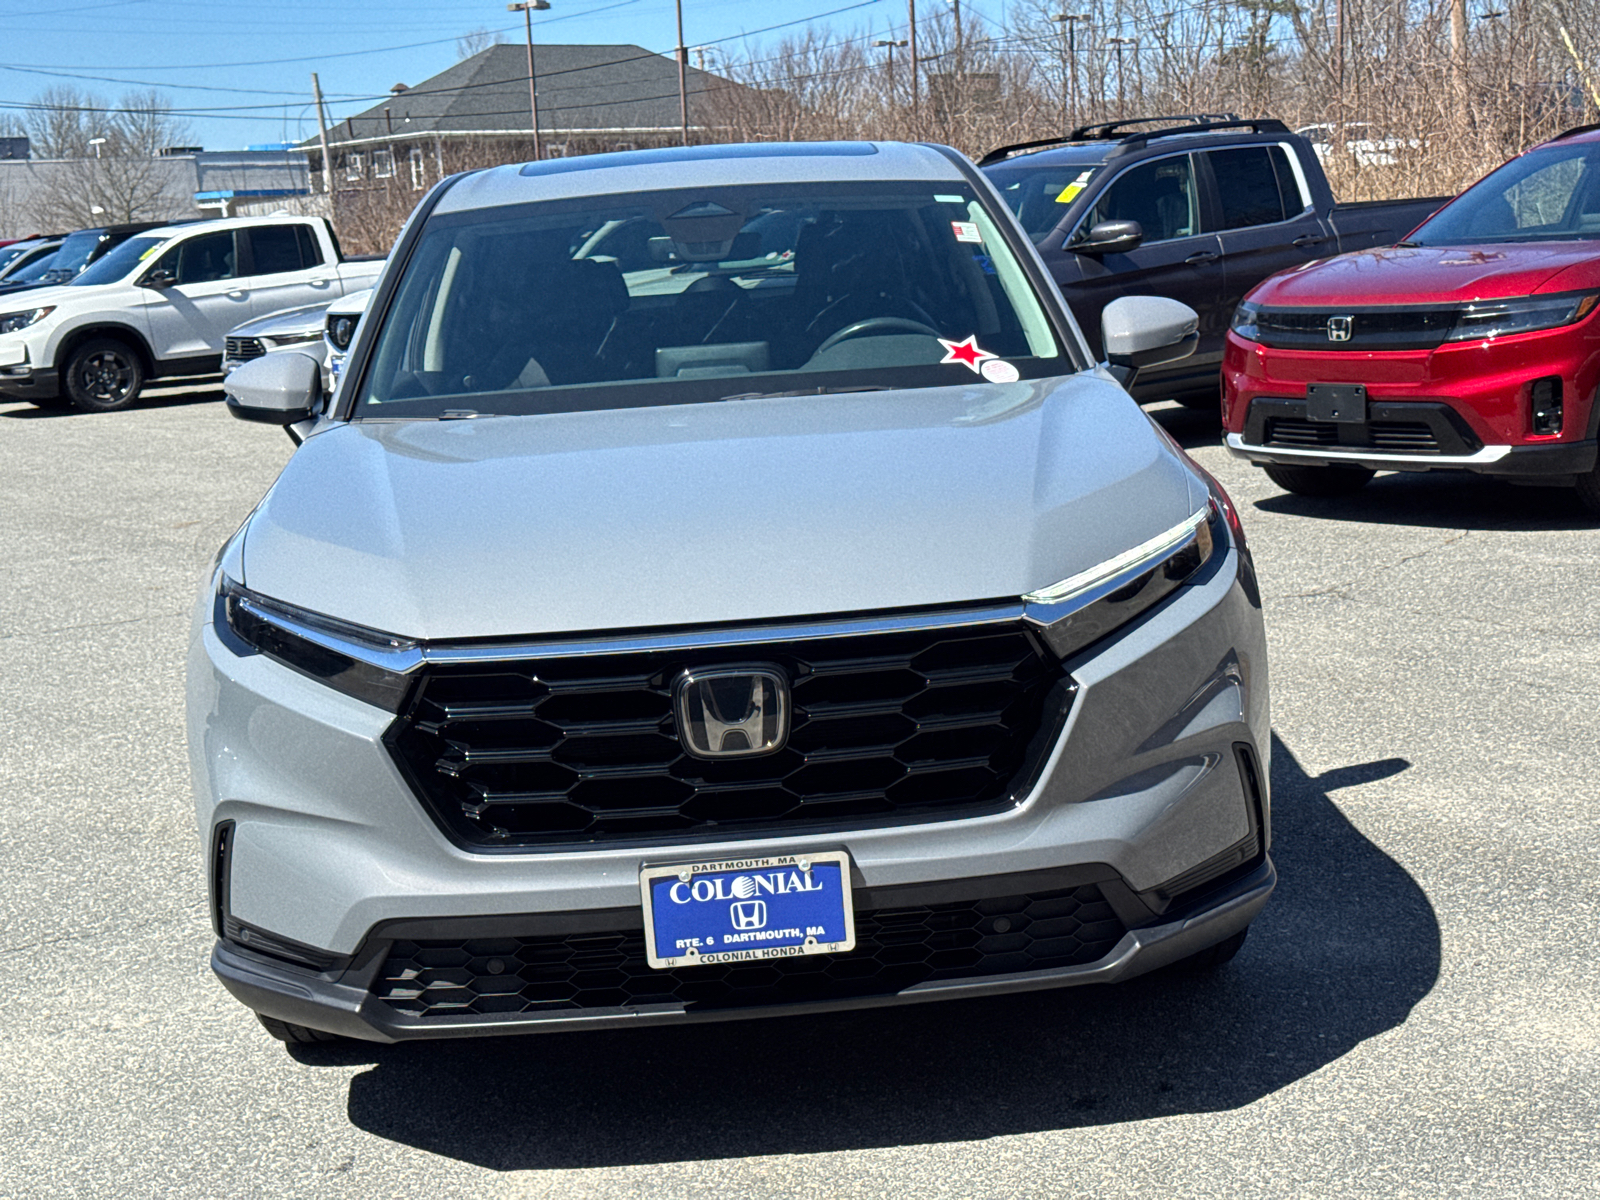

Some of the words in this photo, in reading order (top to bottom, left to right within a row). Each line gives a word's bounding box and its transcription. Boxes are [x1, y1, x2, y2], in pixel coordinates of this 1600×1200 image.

[692, 858, 774, 872] DARTMOUTH,
[778, 856, 796, 865] MA
[669, 871, 823, 904] COLONIAL
[676, 938, 703, 949] RTE.
[706, 936, 714, 945] 6
[723, 928, 804, 944] DARTMOUTH,
[806, 925, 825, 936] MA
[699, 951, 757, 964] COLONIAL
[762, 946, 805, 959] HONDA
